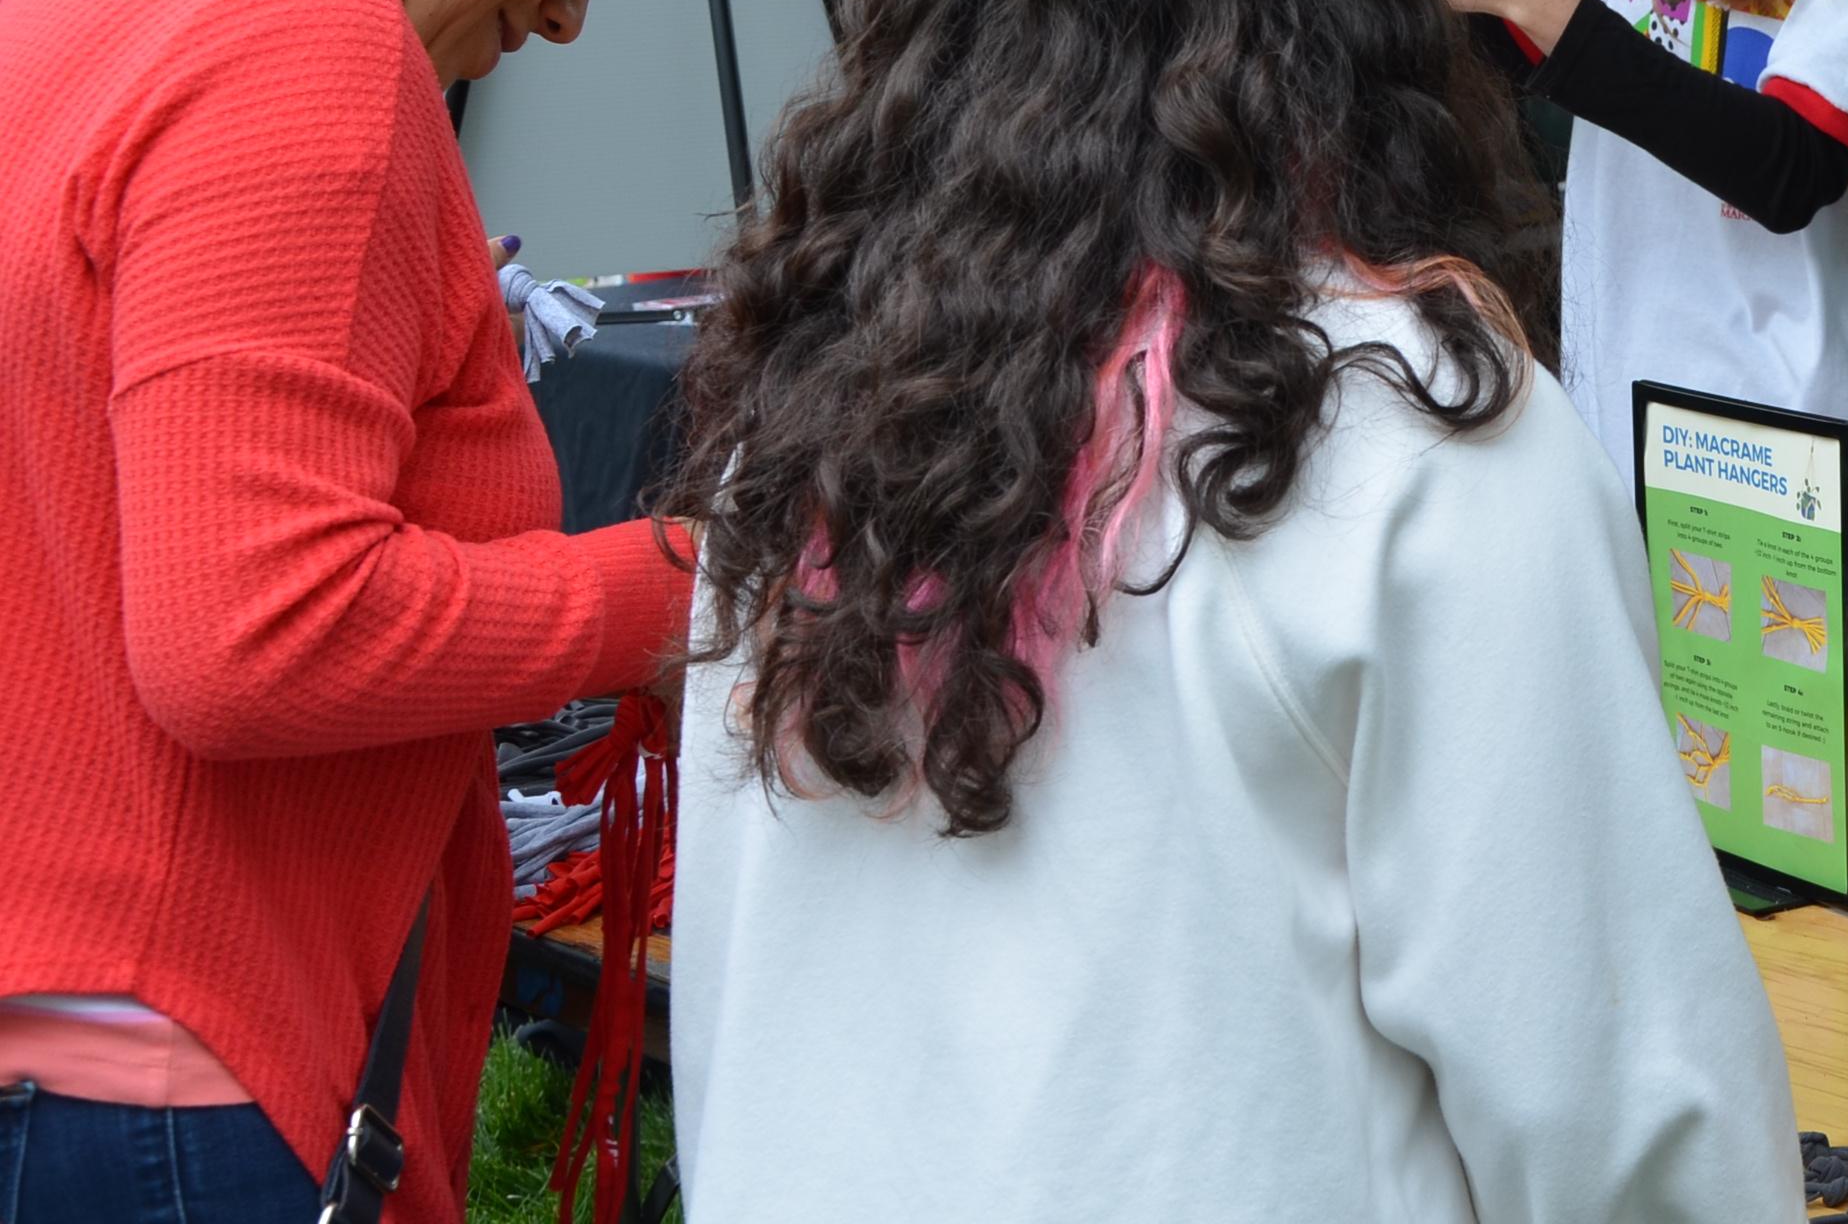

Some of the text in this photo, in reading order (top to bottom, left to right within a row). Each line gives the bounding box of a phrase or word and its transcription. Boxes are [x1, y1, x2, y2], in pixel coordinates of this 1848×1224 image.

[1662, 425, 1773, 467] DIY: MACRAME
[1663, 449, 1788, 496] PLANT HANGERS
